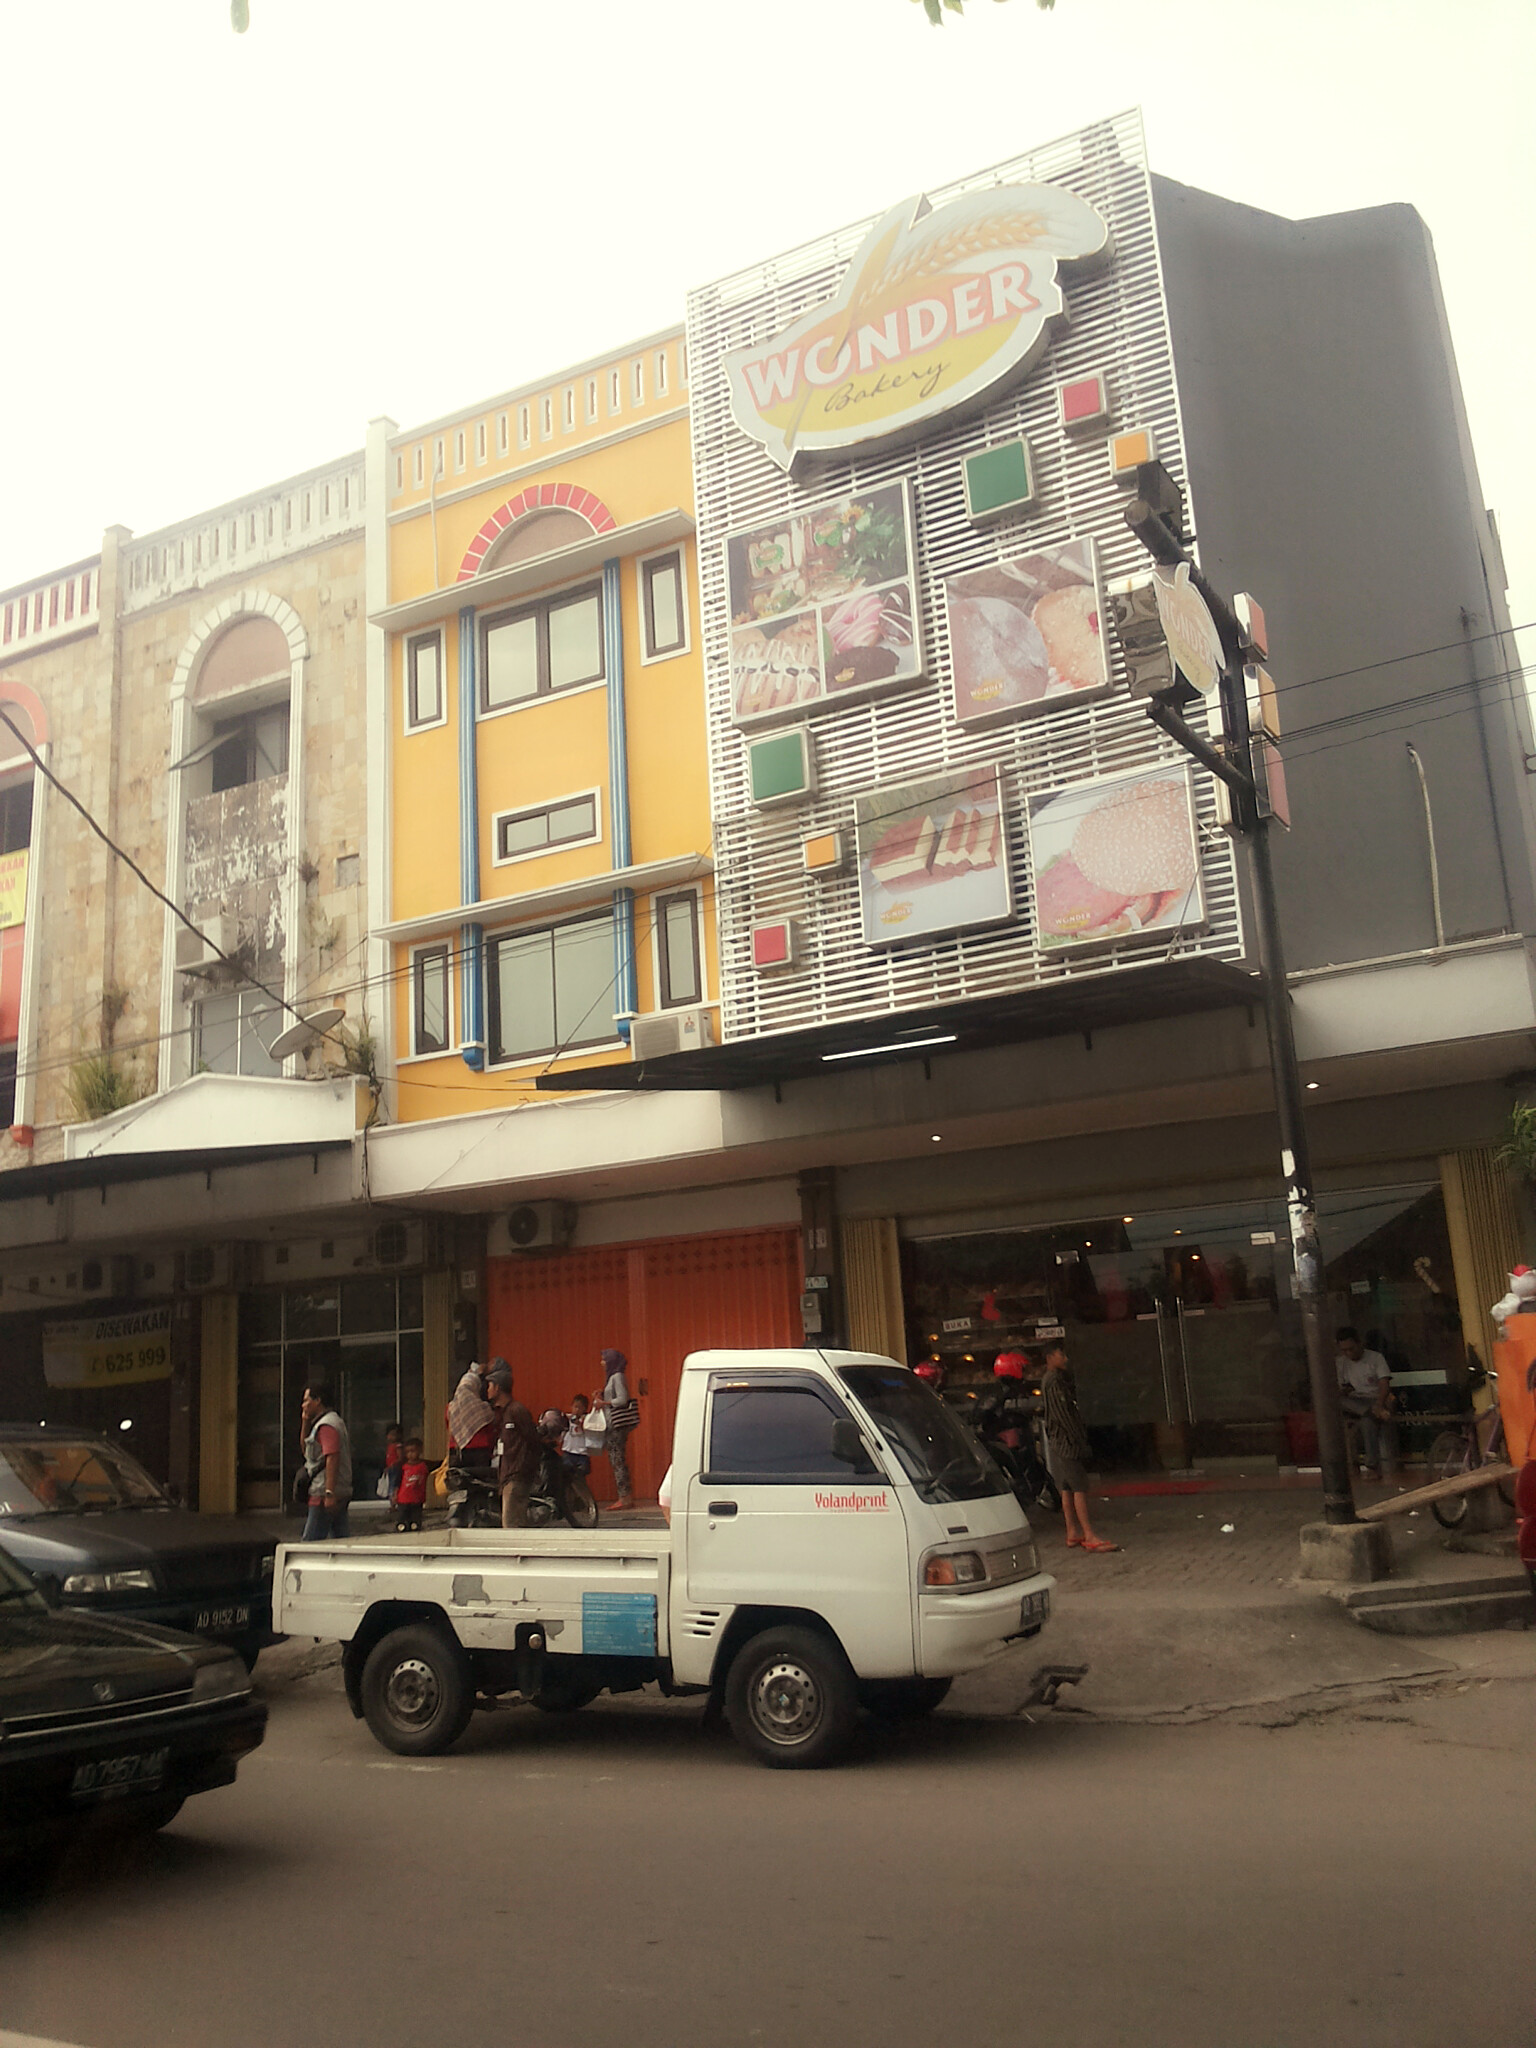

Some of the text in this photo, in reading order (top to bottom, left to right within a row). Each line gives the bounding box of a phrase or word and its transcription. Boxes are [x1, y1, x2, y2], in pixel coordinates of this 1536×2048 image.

[744, 262, 1038, 408] WONDER
[824, 361, 951, 412] Bakery
[1055, 911, 1091, 925] WONDER
[96, 1311, 170, 1340] DISEWAKAN
[945, 1320, 970, 1331] BUKA
[105, 1346, 166, 1373] 625 999
[815, 1490, 888, 1512] Yolandprint
[196, 1611, 209, 1629] AD
[212, 1608, 234, 1626] 9152
